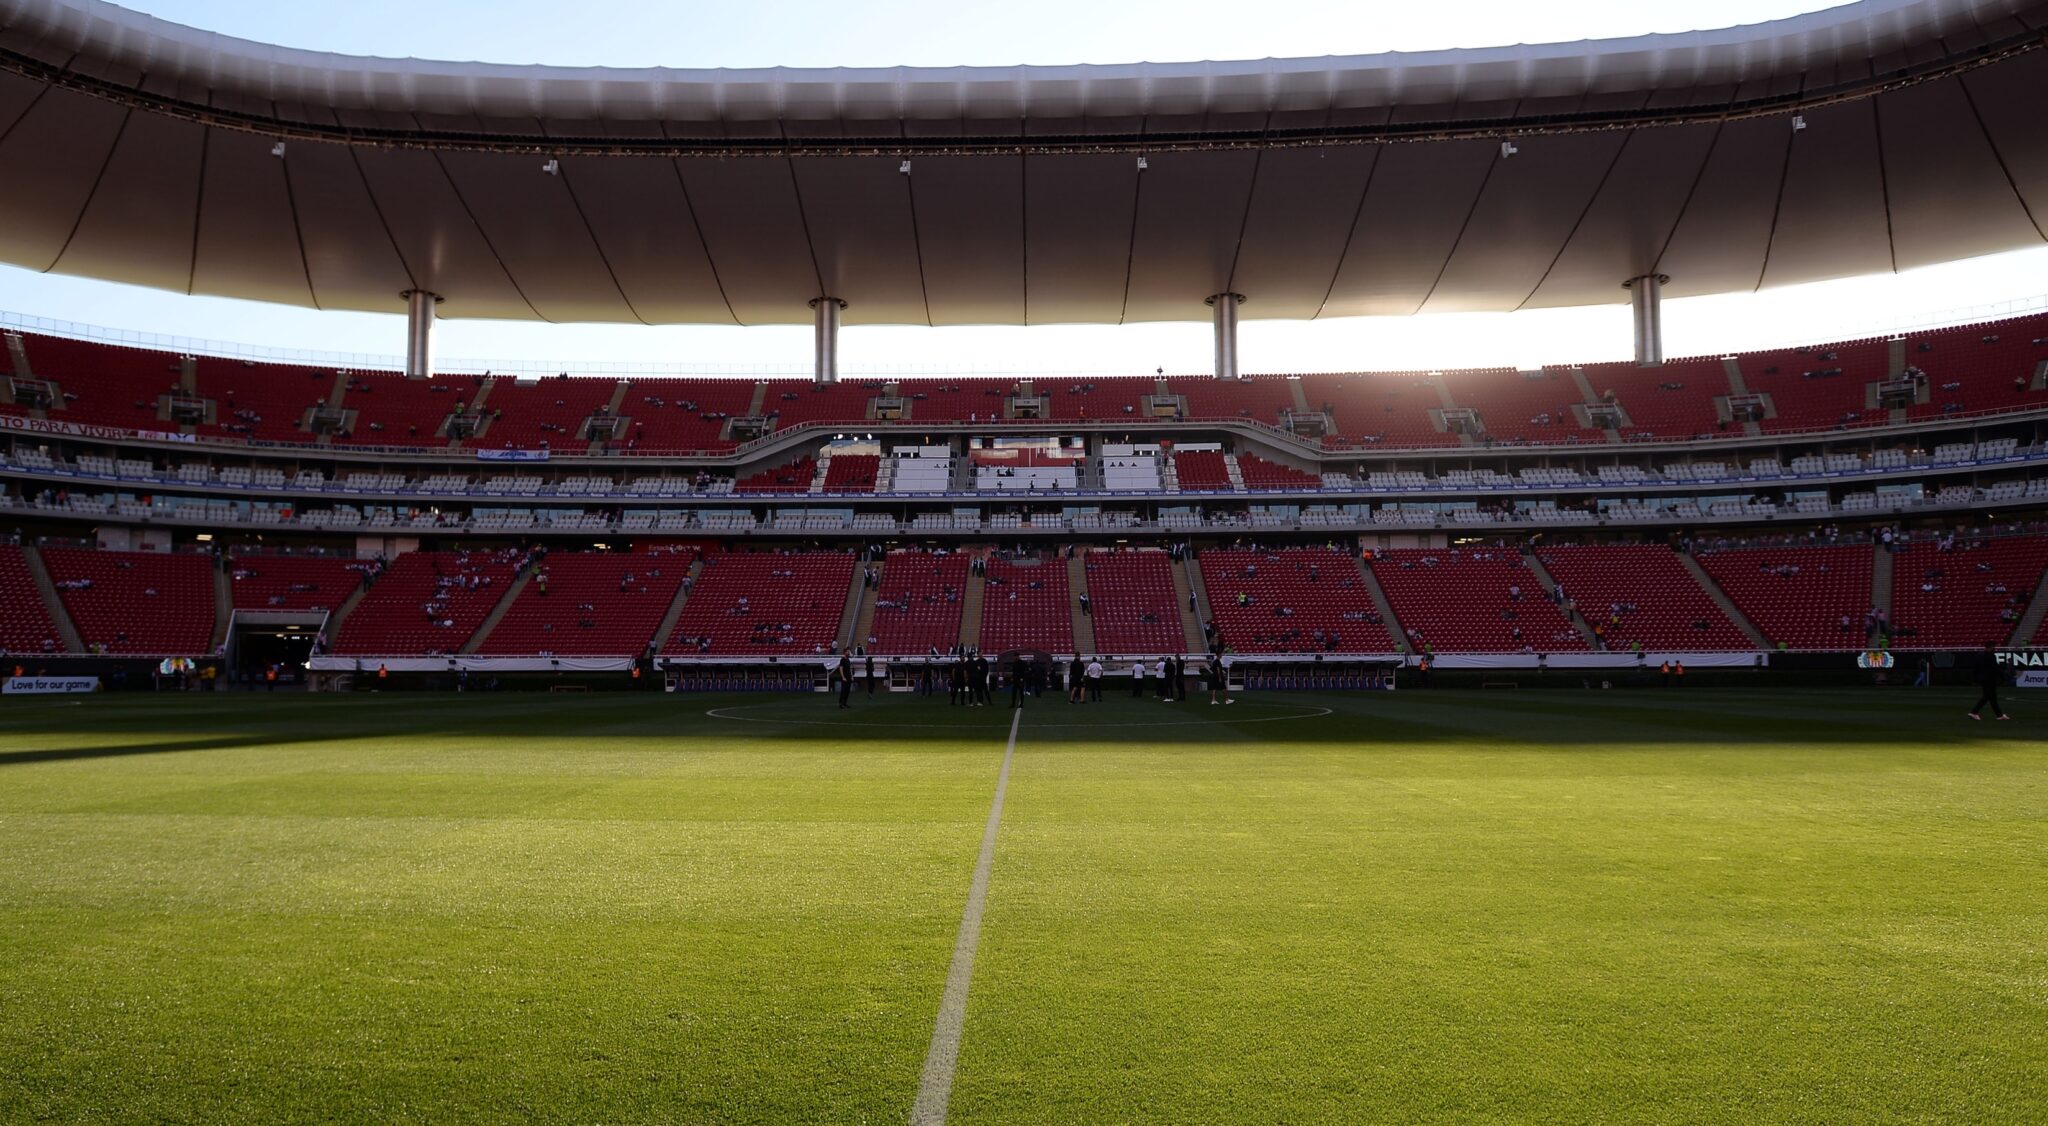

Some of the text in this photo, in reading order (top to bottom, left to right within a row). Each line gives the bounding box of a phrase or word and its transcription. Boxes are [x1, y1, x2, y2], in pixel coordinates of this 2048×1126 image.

[30, 419, 72, 434] PARA
[2024, 674, 2045, 683] Amor
[12, 679, 91, 691] Love for our game
